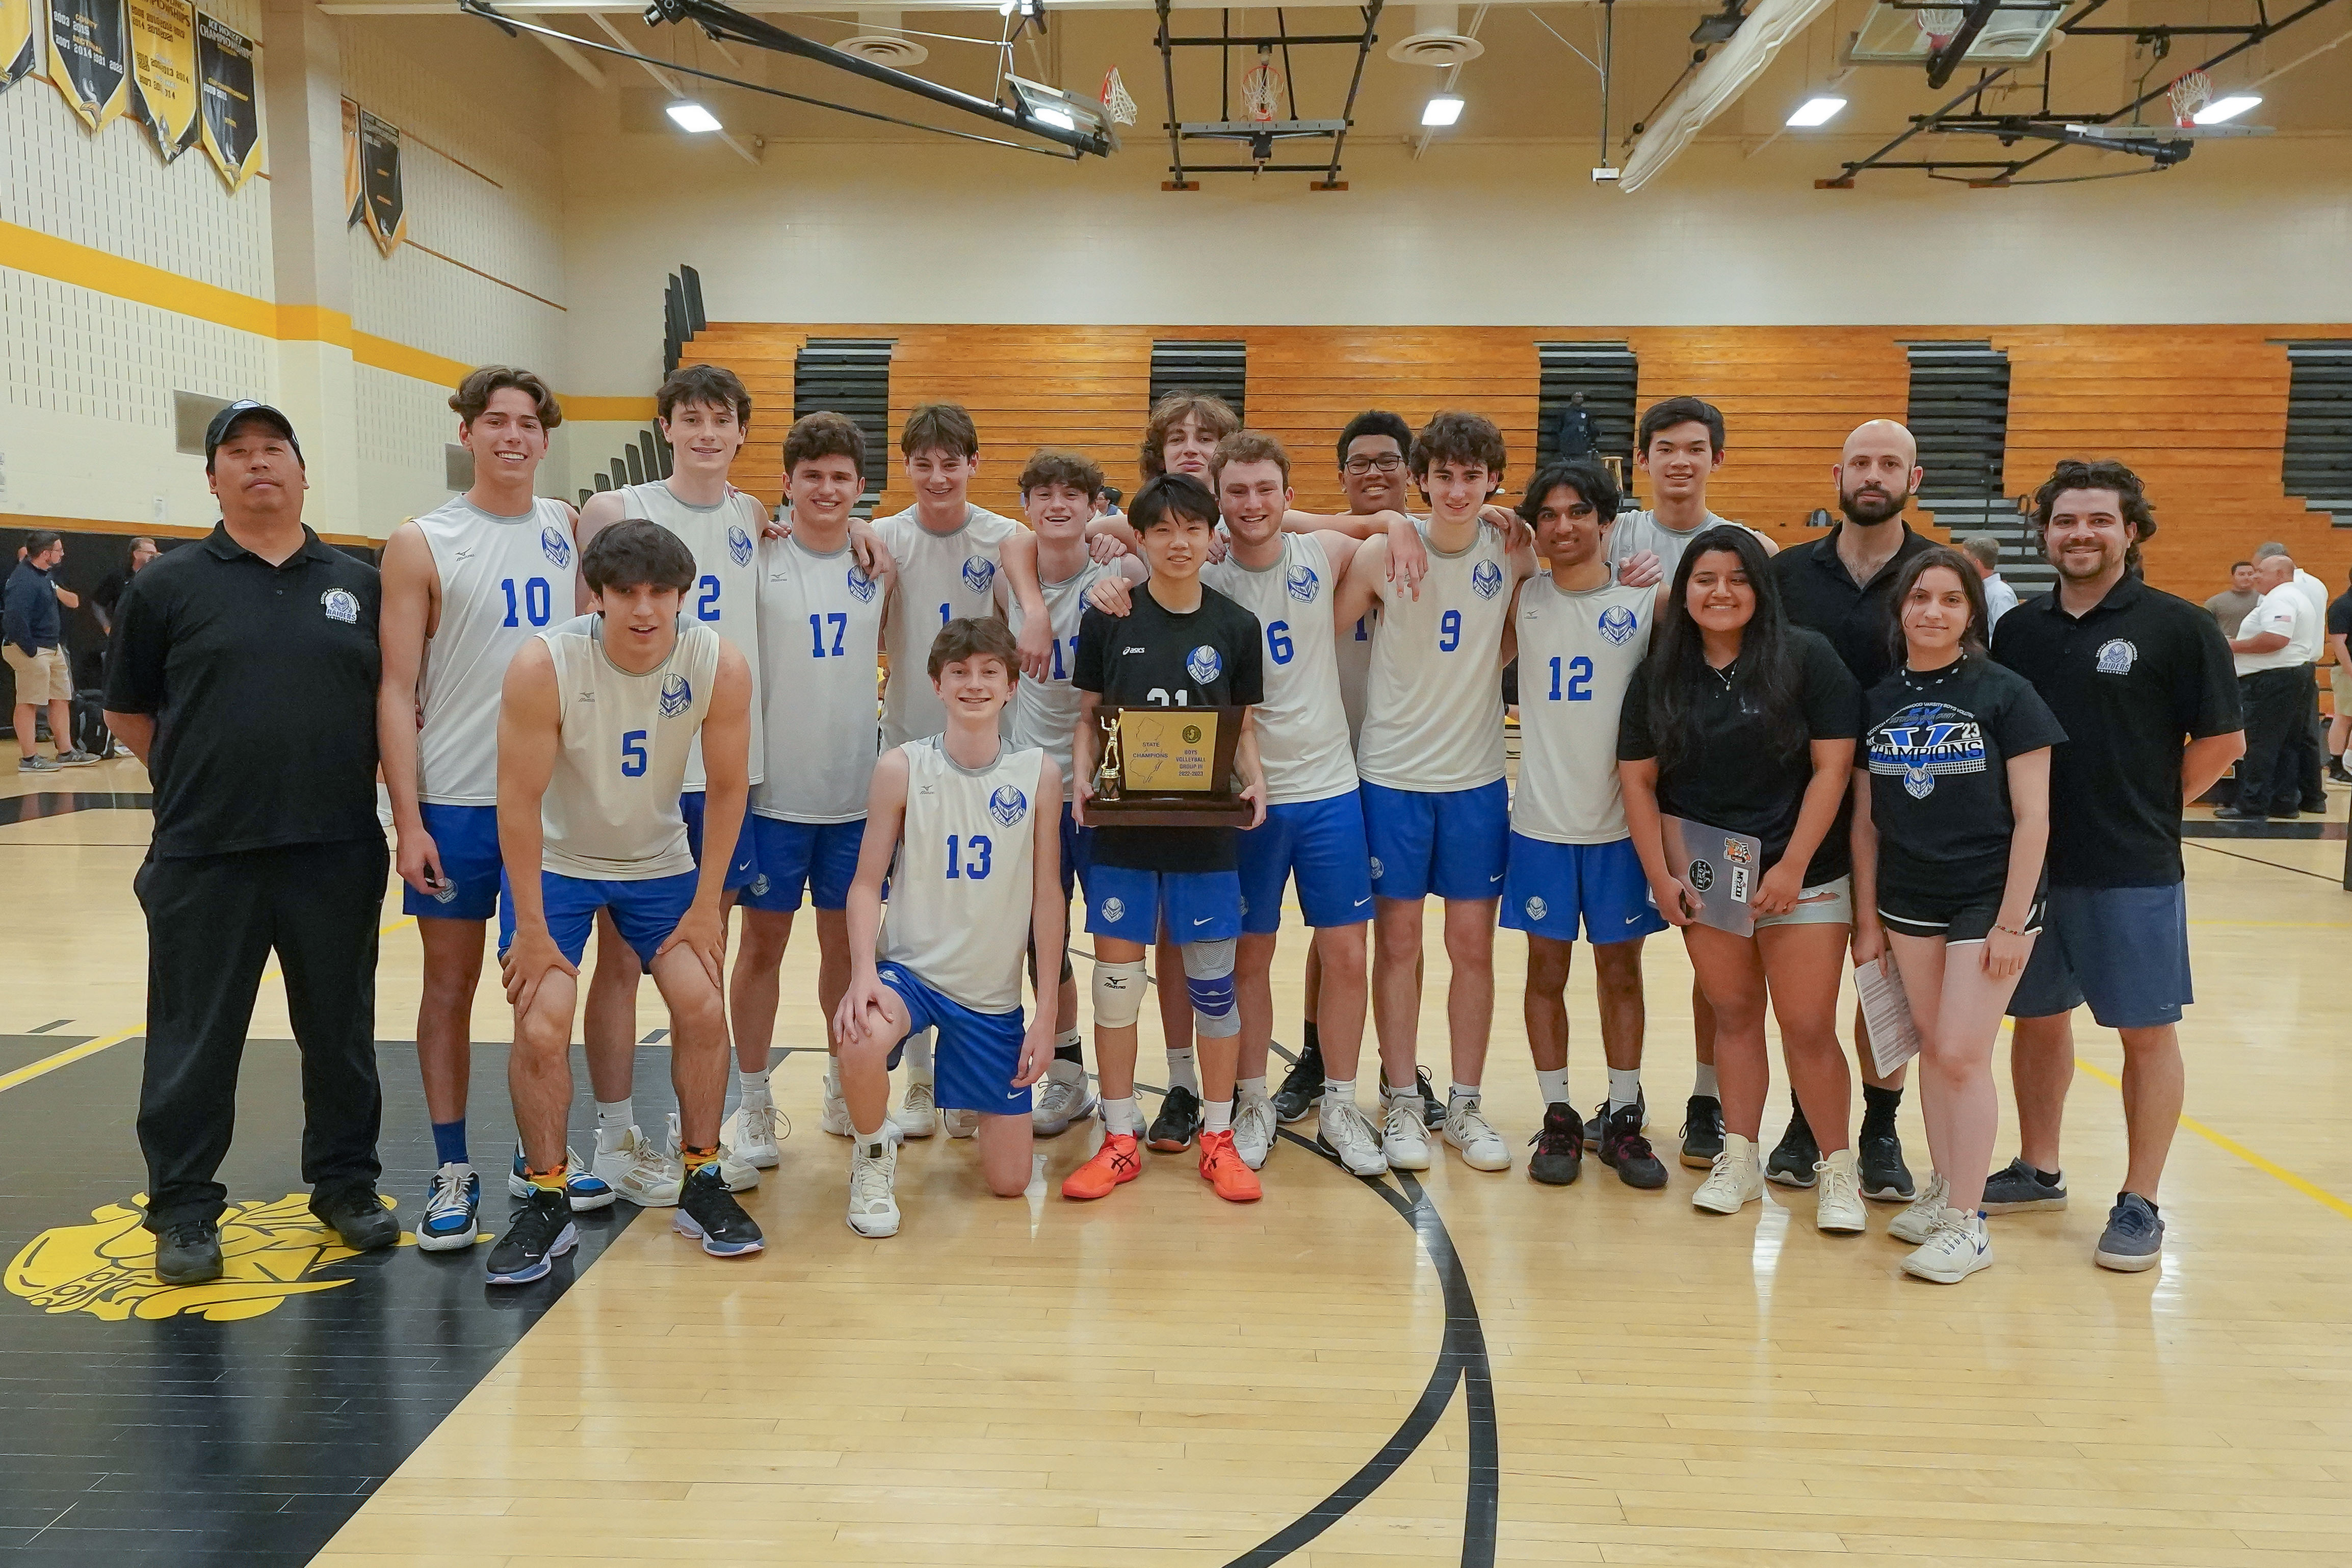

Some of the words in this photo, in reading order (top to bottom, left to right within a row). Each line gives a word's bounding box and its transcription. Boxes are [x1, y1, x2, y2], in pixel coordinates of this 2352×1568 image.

[208, 19, 218, 31] ICE
[219, 25, 243, 45] HOCKEY
[327, 609, 356, 620] RAIDERS
[501, 577, 551, 628] 10
[809, 613, 847, 658] 17
[1266, 619, 1295, 665] 6
[1439, 609, 1461, 652] 9
[1548, 655, 1594, 702] 12
[2098, 662, 2130, 671] RAIDERS
[1867, 721, 1886, 737] SCOTCH
[1943, 703, 1957, 711] BOYS
[1961, 722, 1980, 739] 23
[621, 730, 647, 777] 5
[1869, 741, 1983, 762] CHAMPIONS
[946, 834, 992, 880] 13
